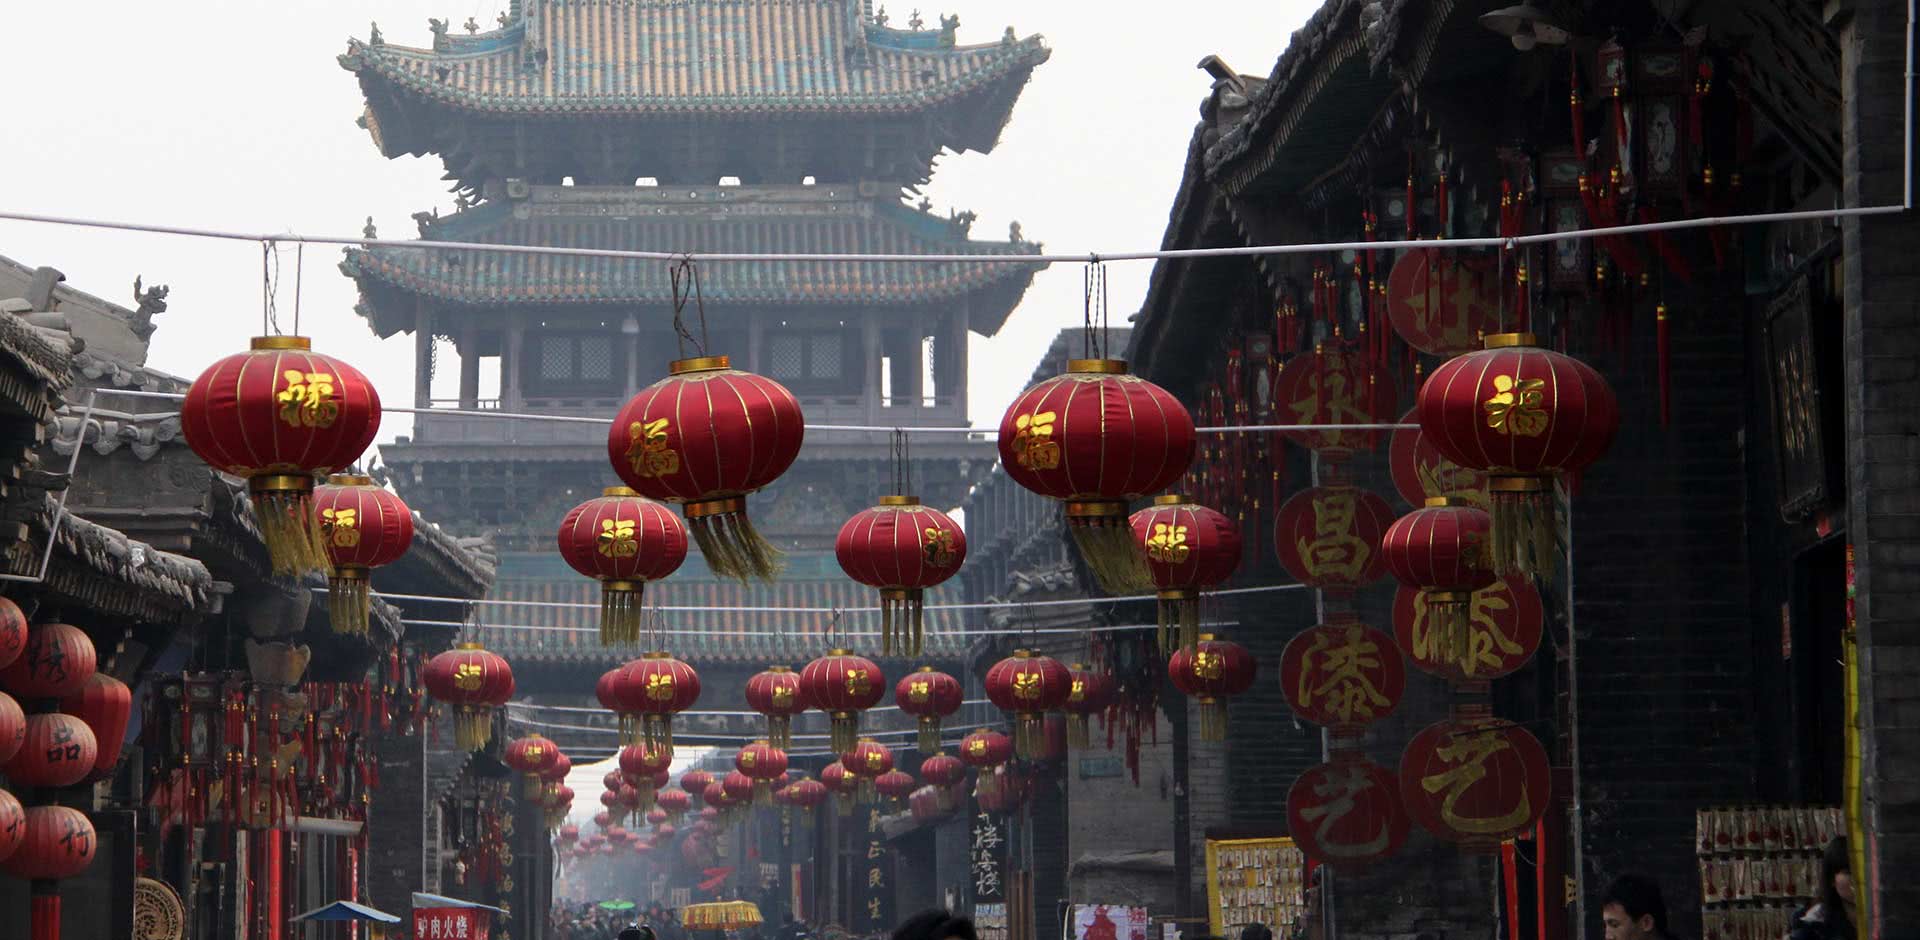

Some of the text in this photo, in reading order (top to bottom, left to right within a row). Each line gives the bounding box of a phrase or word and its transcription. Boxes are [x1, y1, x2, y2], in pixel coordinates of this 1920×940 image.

[277, 370, 338, 428] 福
[1483, 374, 1549, 437] 福
[624, 418, 679, 477] 福
[1011, 411, 1060, 470] 福
[320, 508, 360, 547] 福
[596, 519, 638, 558] 福
[1298, 496, 1369, 577] 昌
[1298, 625, 1391, 720] 漆
[47, 725, 80, 760] 品
[1422, 727, 1531, 833] 艺
[1299, 768, 1389, 857] 艺
[417, 915, 468, 939] 驴肉火烧
